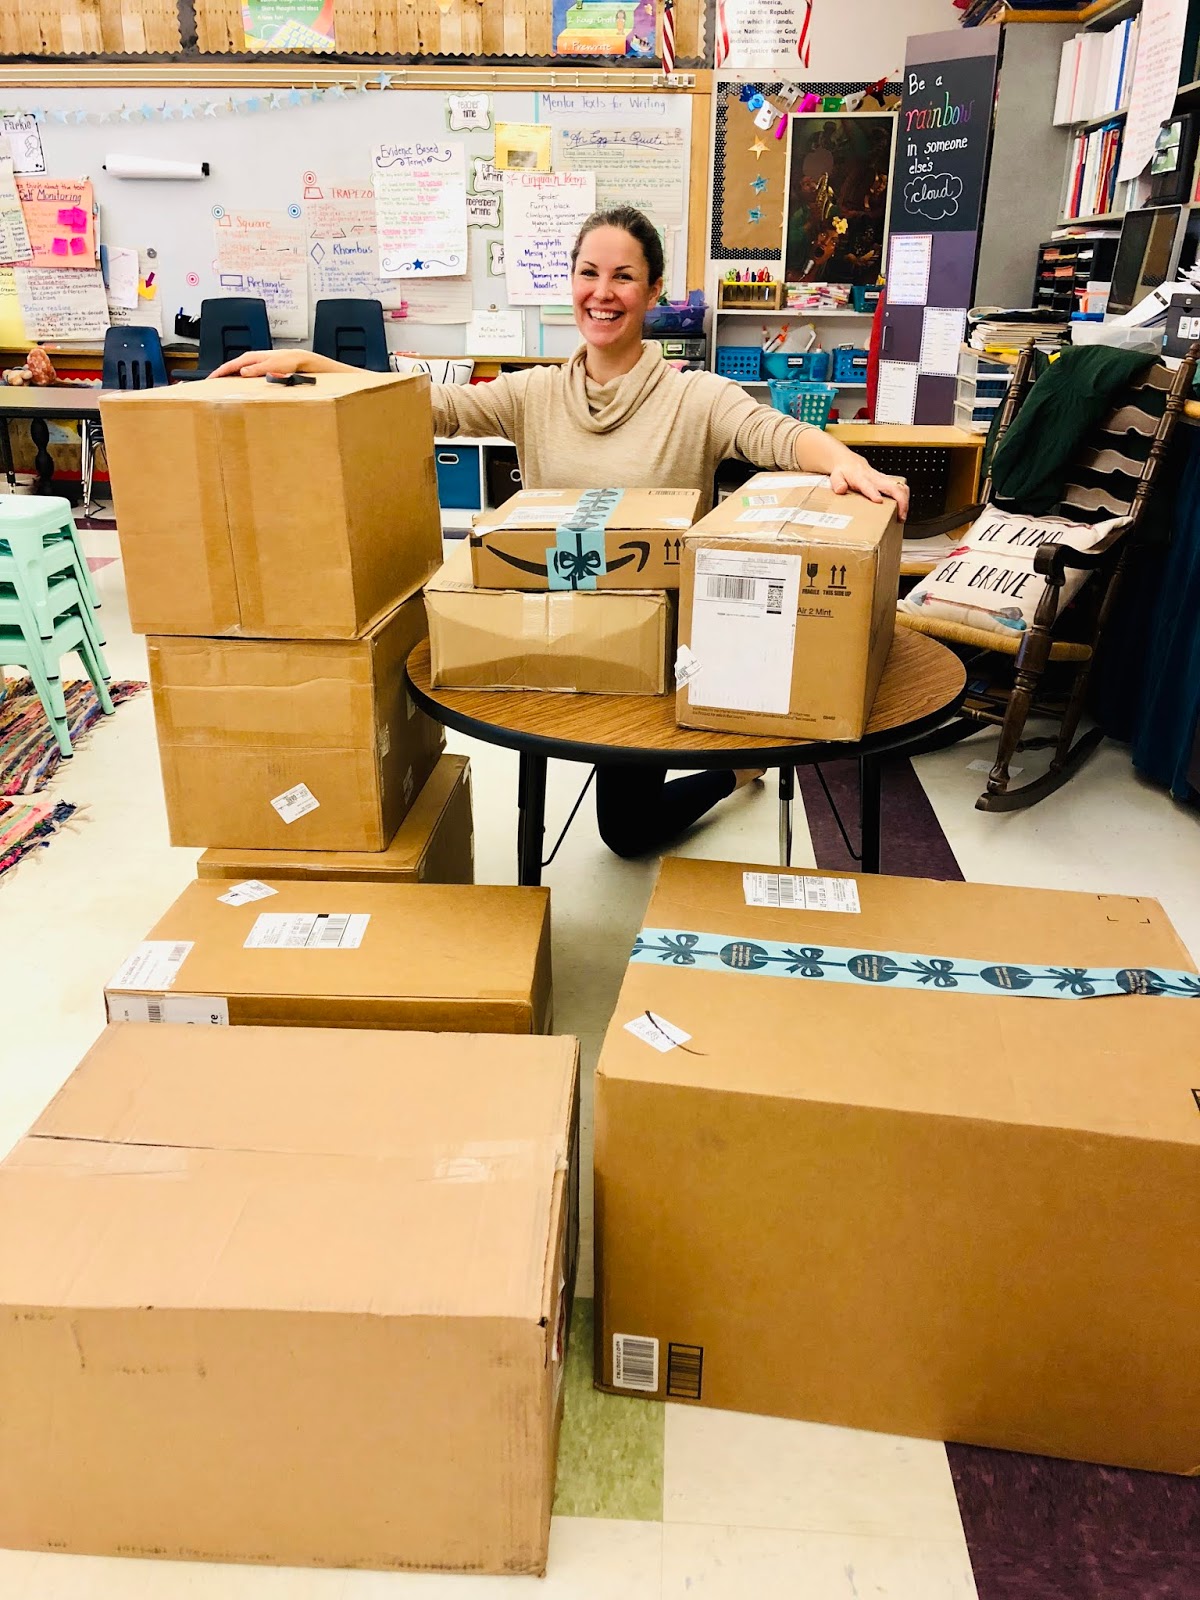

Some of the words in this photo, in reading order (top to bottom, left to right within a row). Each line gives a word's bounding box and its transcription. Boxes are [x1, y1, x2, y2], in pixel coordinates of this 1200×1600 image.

[908, 73, 925, 95] Be
[935, 75, 943, 86] a
[542, 94, 574, 111] Mentor
[582, 95, 606, 108] Texts
[610, 94, 622, 109] for
[629, 94, 666, 113] Writing
[905, 91, 975, 132] rainbow
[566, 131, 587, 147] An
[590, 130, 607, 149] Egg
[613, 131, 626, 143] Is
[907, 137, 917, 157] in
[923, 137, 968, 155] someone
[380, 144, 413, 158] Evidence
[415, 143, 439, 155] Based
[404, 156, 427, 166] Terms
[908, 157, 934, 175] else's
[36, 189, 82, 206] Monitoring
[537, 193, 560, 202] Spider
[910, 178, 954, 202] cloud
[236, 215, 271, 233] Square
[333, 241, 373, 255] Rhombus
[533, 238, 562, 249] Spaghetti
[247, 276, 285, 293] Rectangle
[978, 522, 1013, 542] BE
[935, 560, 970, 584] BE
[967, 564, 1037, 599] BRAVE
[816, 608, 831, 616] Mint
